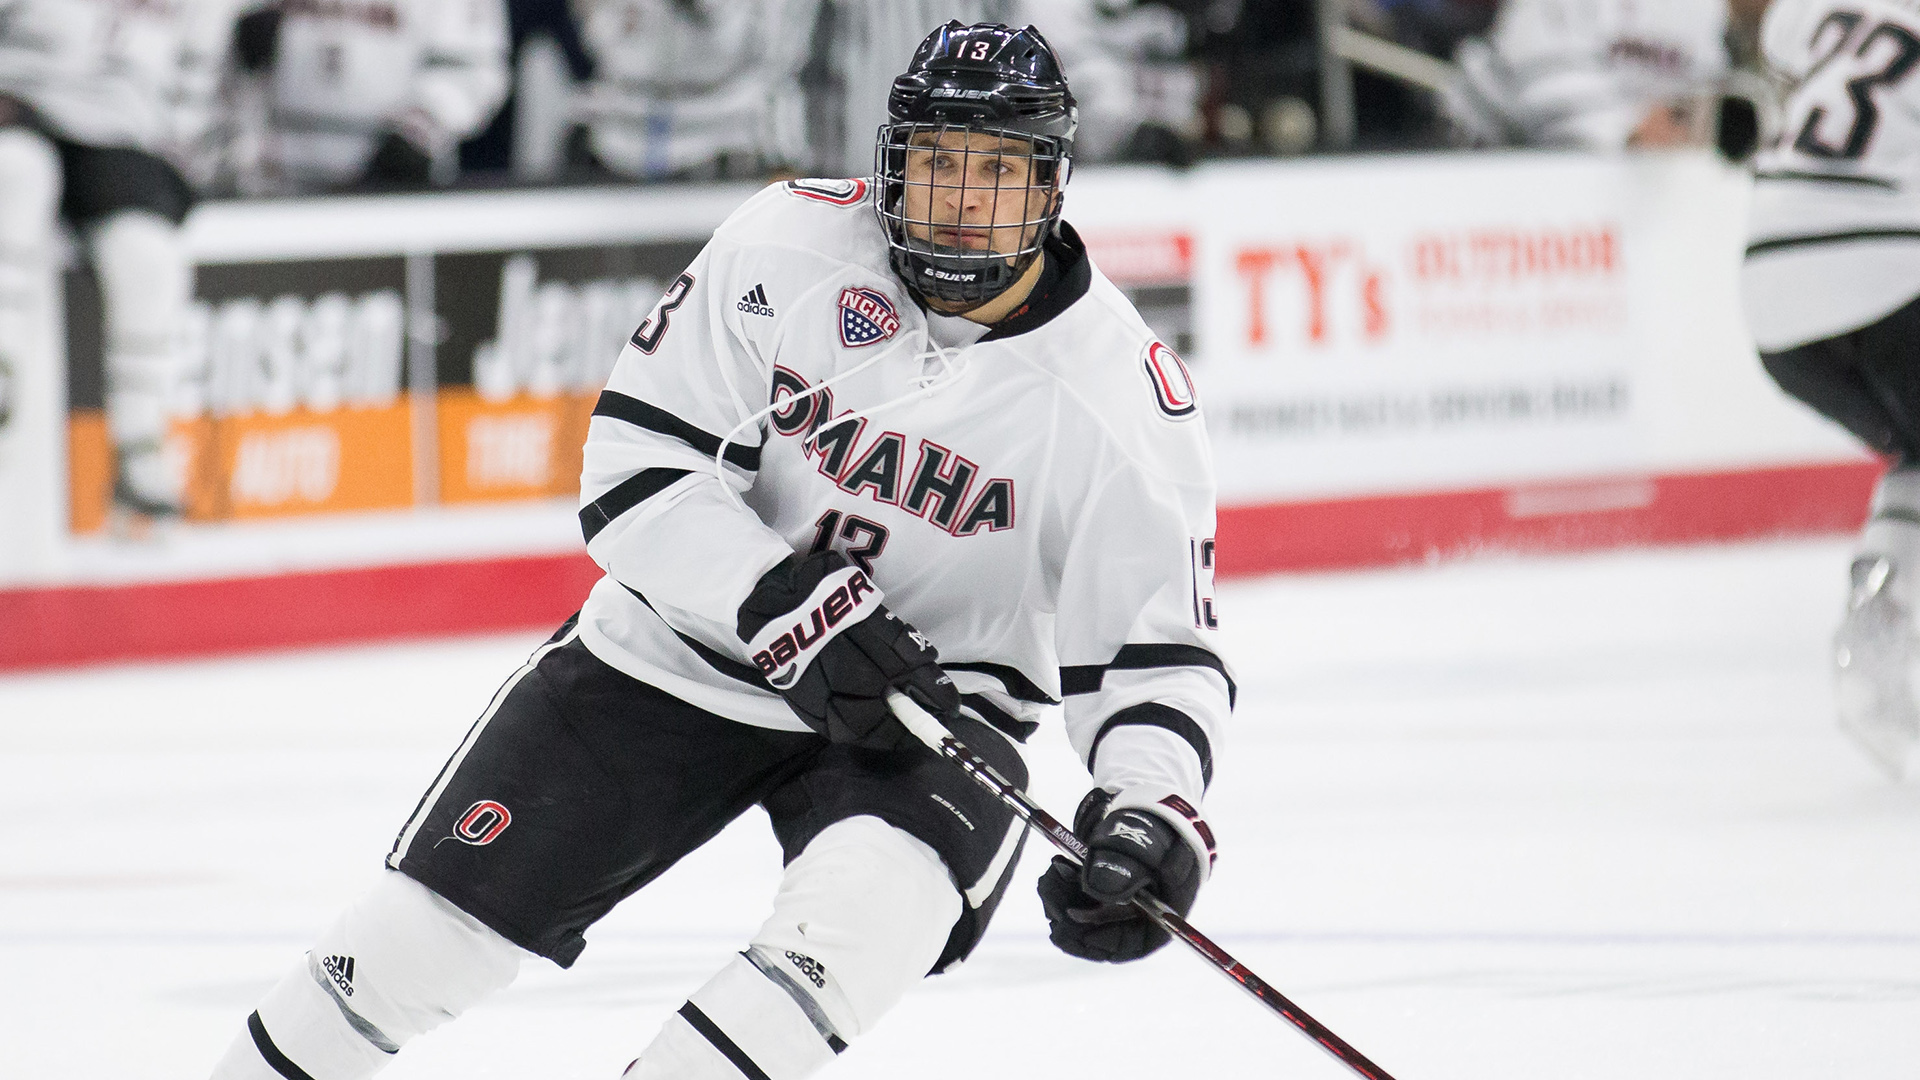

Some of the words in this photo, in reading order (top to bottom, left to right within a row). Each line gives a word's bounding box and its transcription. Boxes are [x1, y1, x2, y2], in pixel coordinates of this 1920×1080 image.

[956, 40, 990, 61] 13
[736, 300, 775, 318] adidas
[840, 290, 899, 337] NCHC
[769, 363, 1015, 538] OMAHA
[752, 570, 875, 678] BAUER
[1053, 826, 1089, 859] RANDOLP
[322, 956, 354, 998] adidas
[784, 950, 827, 989] adidas
